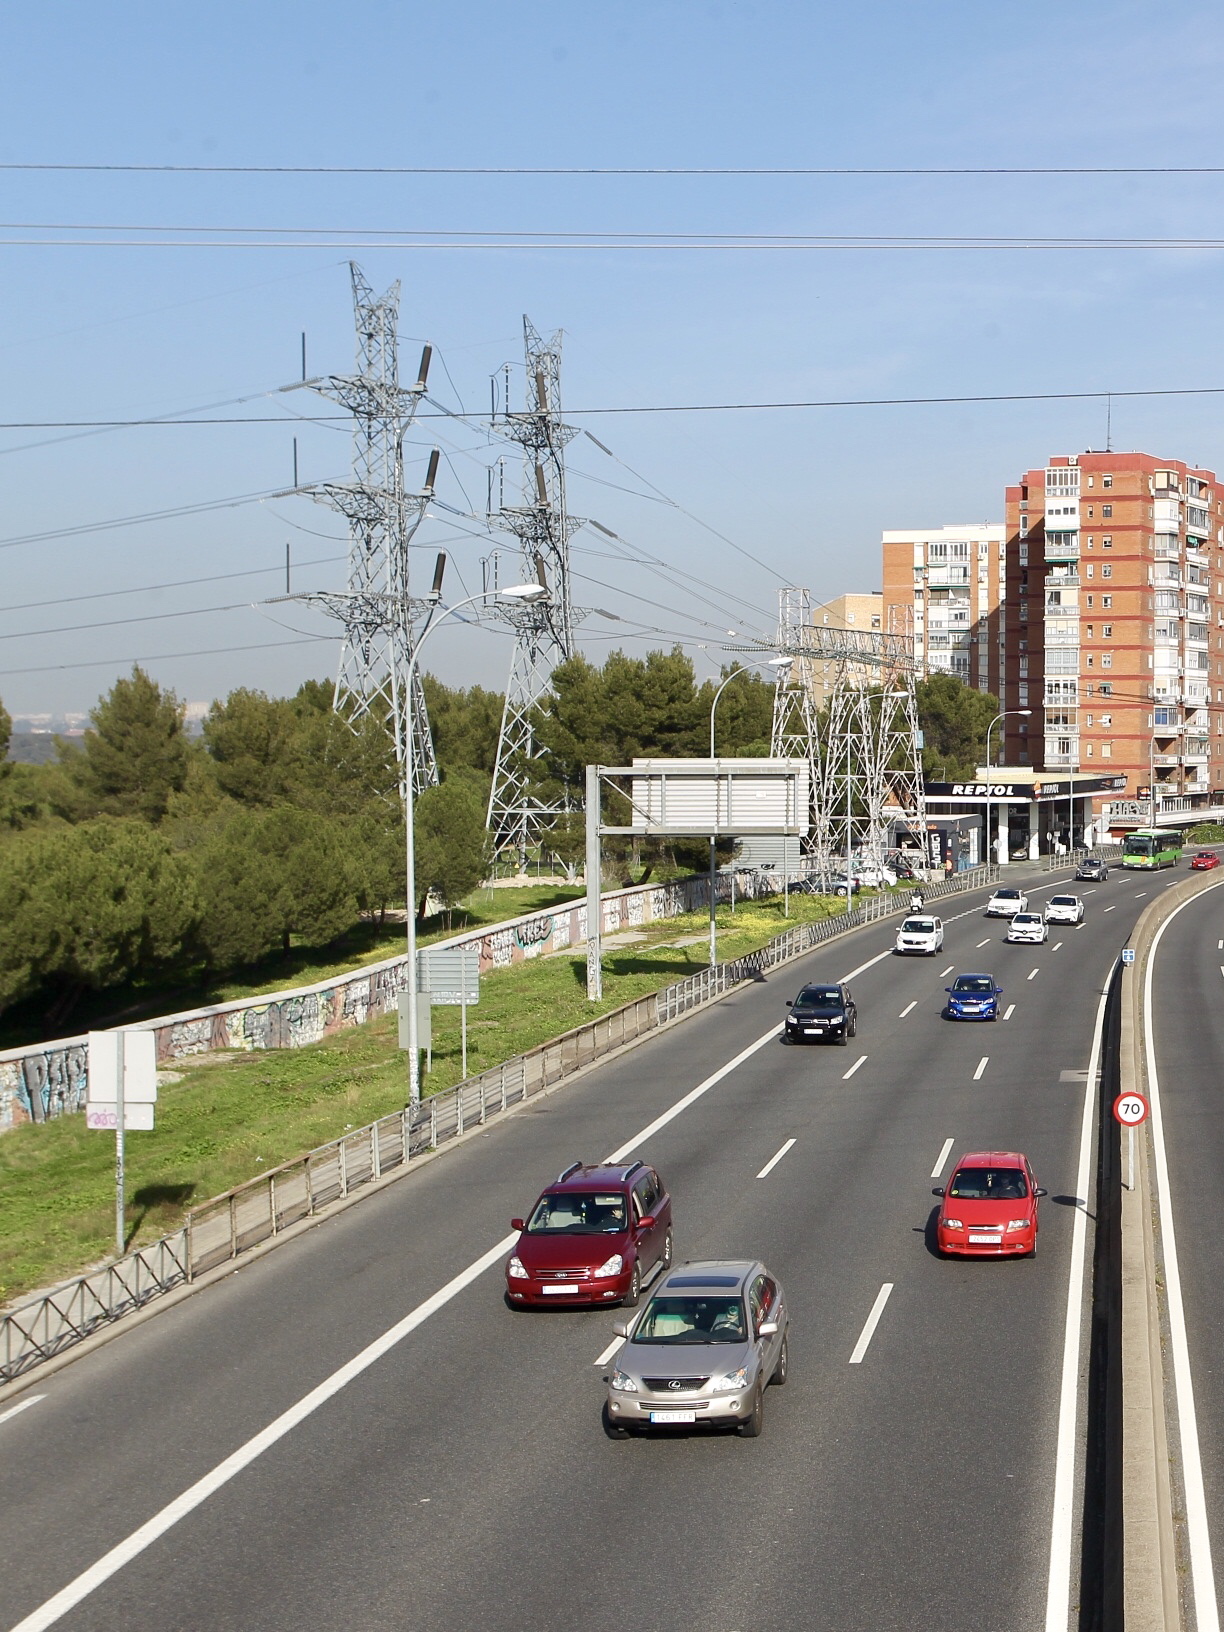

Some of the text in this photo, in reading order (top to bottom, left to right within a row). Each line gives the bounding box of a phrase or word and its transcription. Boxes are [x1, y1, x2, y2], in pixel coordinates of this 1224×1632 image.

[952, 785, 1014, 796] REPSOL
[1044, 784, 1059, 794] REPSOL
[1122, 1103, 1140, 1116] 70
